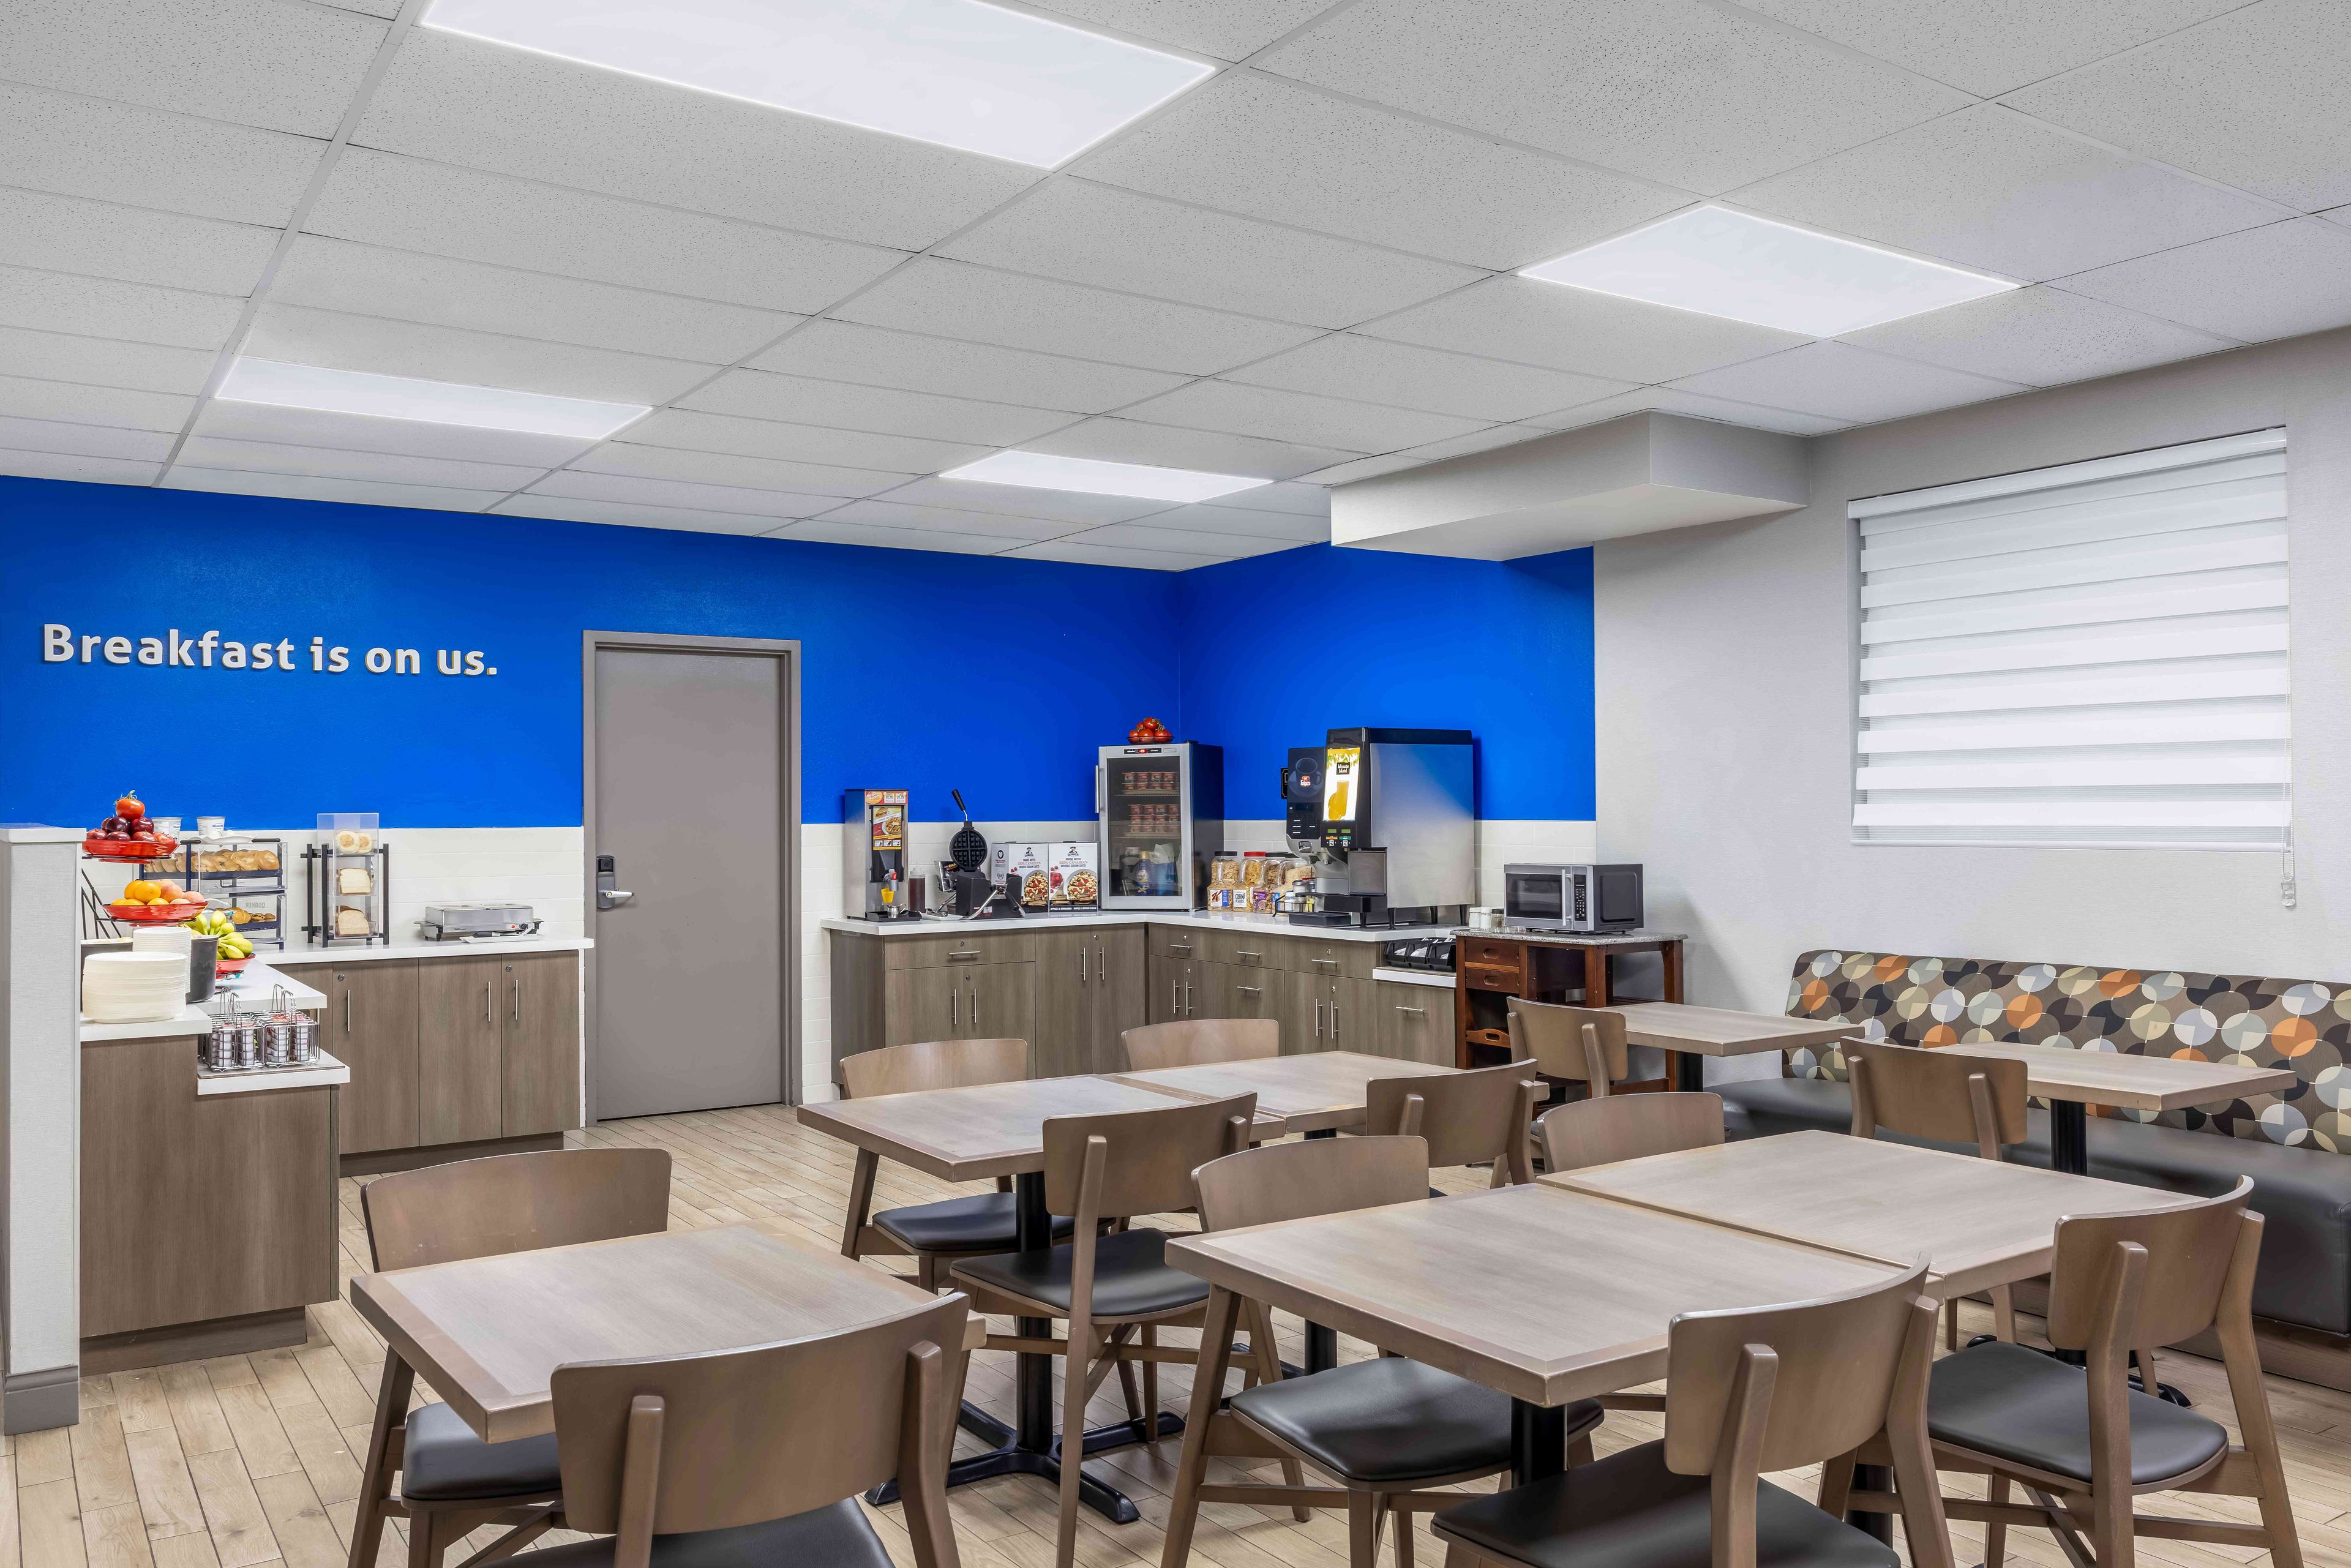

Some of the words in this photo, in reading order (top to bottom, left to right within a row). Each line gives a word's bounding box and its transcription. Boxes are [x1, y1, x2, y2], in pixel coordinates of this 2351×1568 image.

[43, 623, 295, 671] Breakfast
[310, 637, 349, 673] is
[365, 647, 420, 675] on
[437, 650, 497, 676] us.
